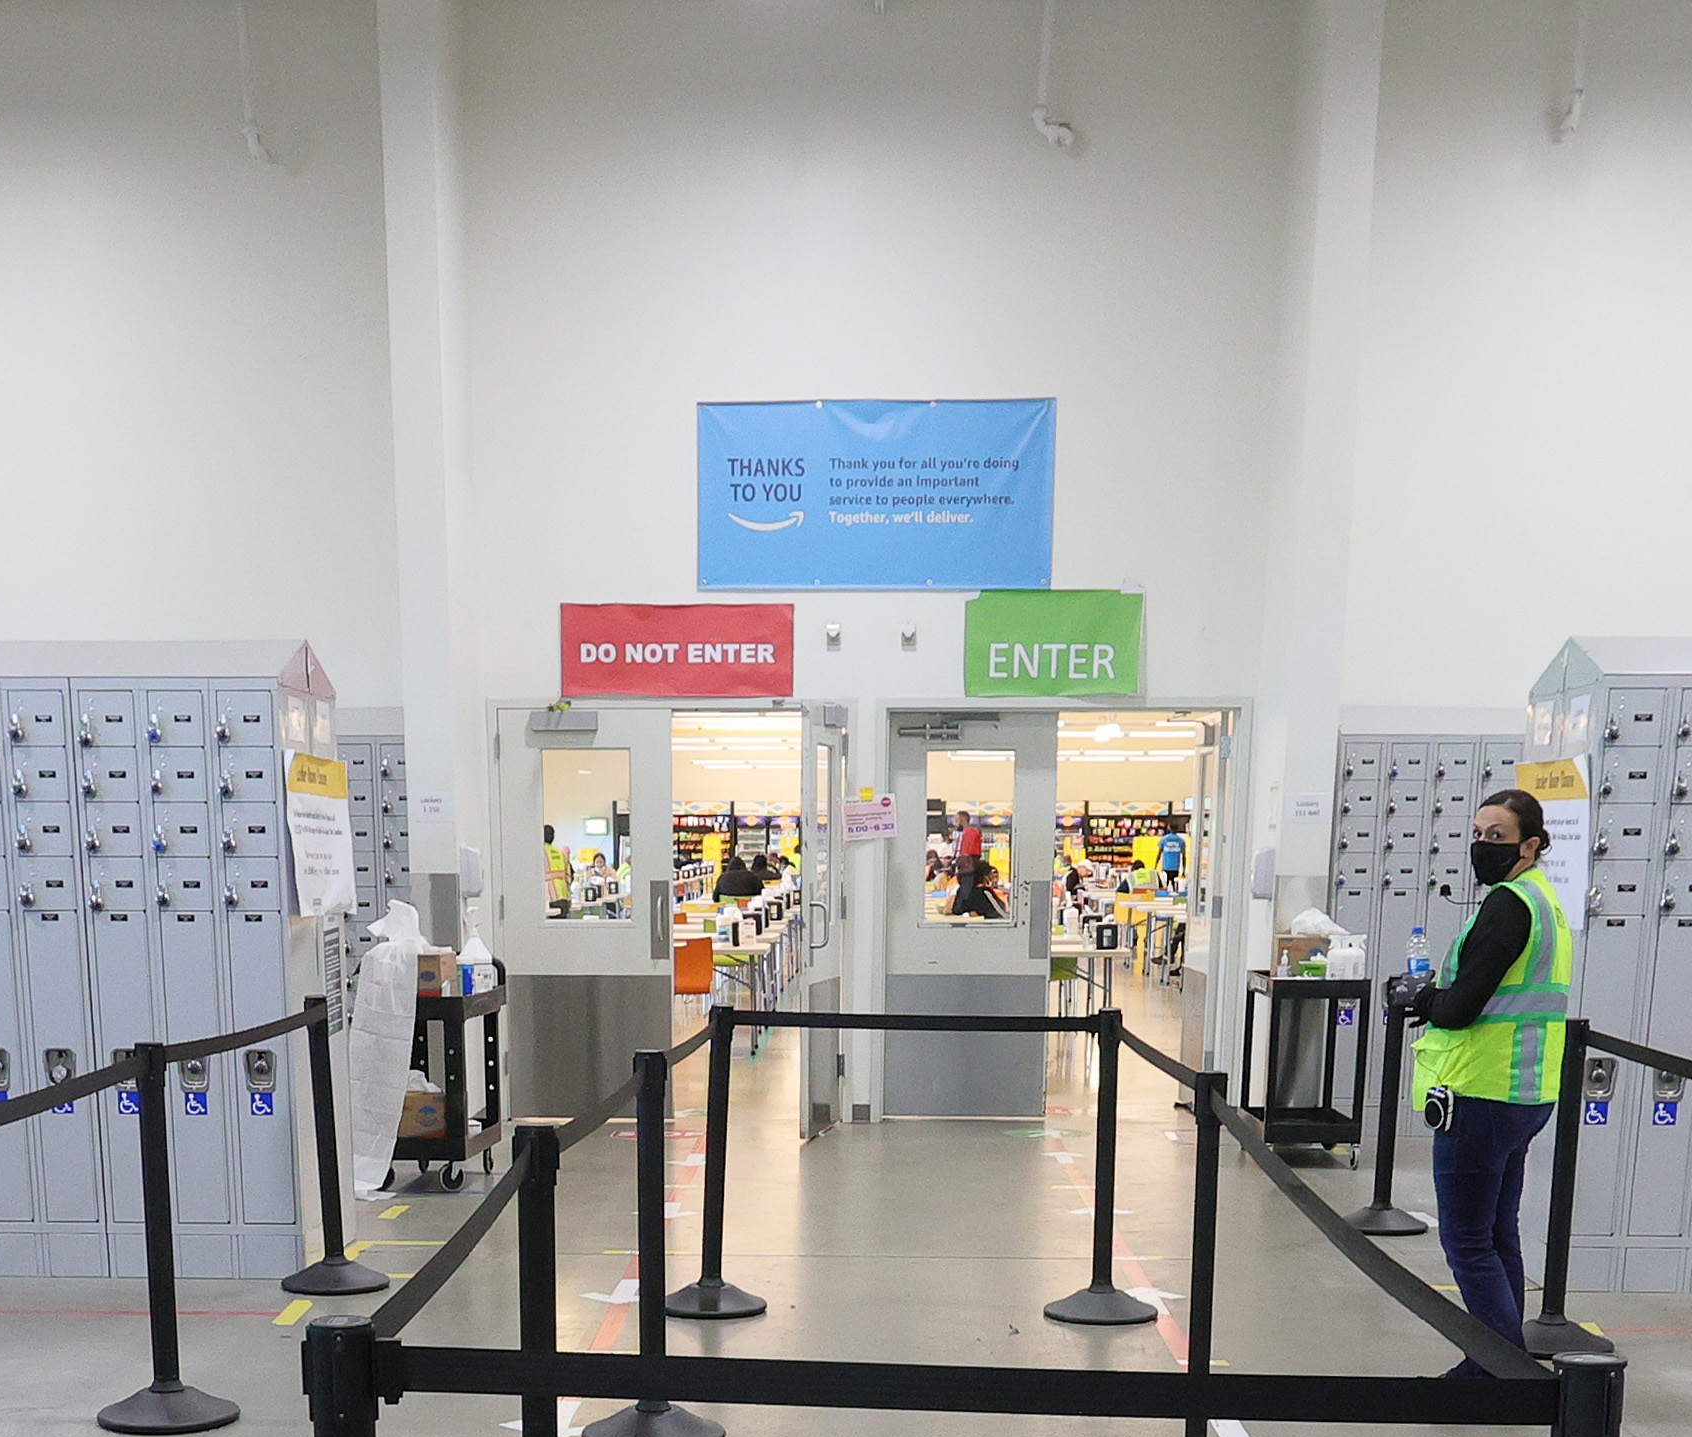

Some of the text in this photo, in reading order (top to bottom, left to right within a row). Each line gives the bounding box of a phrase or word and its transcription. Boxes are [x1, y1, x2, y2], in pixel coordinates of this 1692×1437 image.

[727, 458, 805, 477] THANKS
[829, 457, 1019, 472] Thank you for all you're doing
[829, 475, 979, 490] to provide an important
[730, 483, 802, 502] TO YOU
[829, 494, 1015, 508] service to people everywhere.
[828, 510, 974, 526] Together, we'll deliver.
[579, 643, 775, 663] DO NOT ENTER
[989, 643, 1115, 679] ENTER
